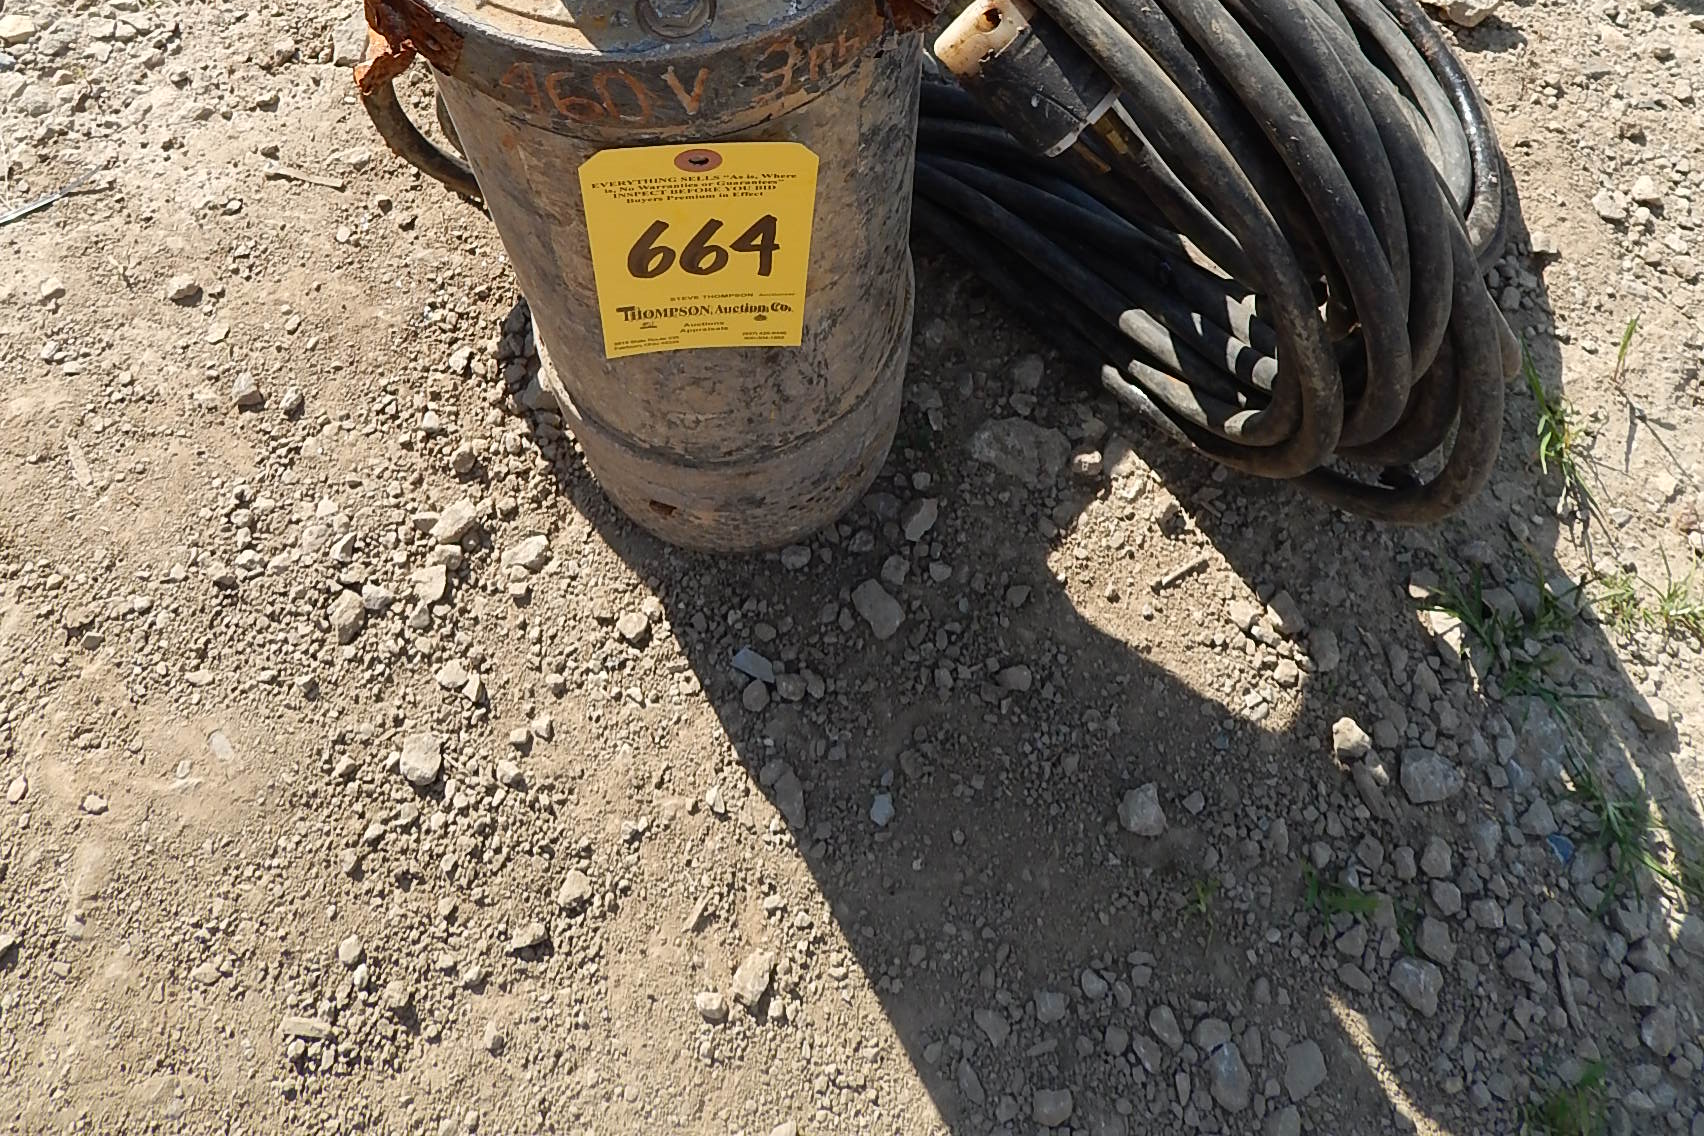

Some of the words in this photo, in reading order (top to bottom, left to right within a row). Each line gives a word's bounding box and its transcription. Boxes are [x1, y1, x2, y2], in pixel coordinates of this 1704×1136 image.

[591, 177, 677, 189] EVERYTHING
[638, 182, 698, 190] Warranties
[613, 190, 666, 199] INSPECT
[670, 186, 721, 195] BEFORE
[627, 214, 780, 279] 664
[703, 292, 754, 300] THOMPSON
